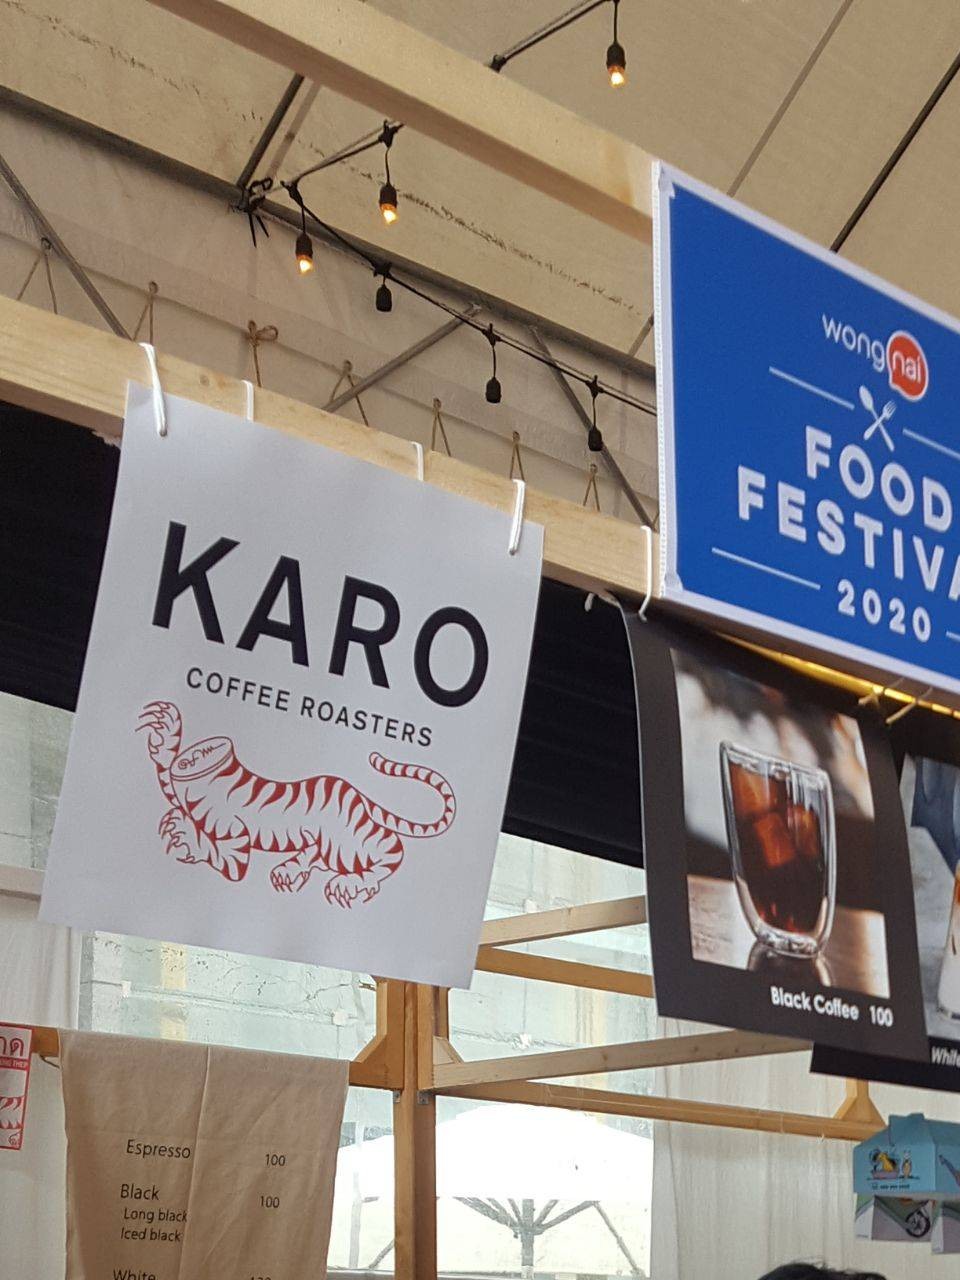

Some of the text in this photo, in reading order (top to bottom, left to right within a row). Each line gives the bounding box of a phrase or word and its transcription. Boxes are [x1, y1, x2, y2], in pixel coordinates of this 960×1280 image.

[806, 425, 953, 532] FOOD
[152, 521, 490, 708] KARO
[838, 581, 932, 642] 2020
[187, 667, 433, 748] COFFEE ROASTERS
[770, 985, 894, 1027] Black Coffee 100
[126, 1139, 286, 1167] Espresso 100
[120, 1183, 280, 1209] Black 100
[123, 1207, 188, 1223] Long black
[121, 1227, 182, 1242] Iced black
